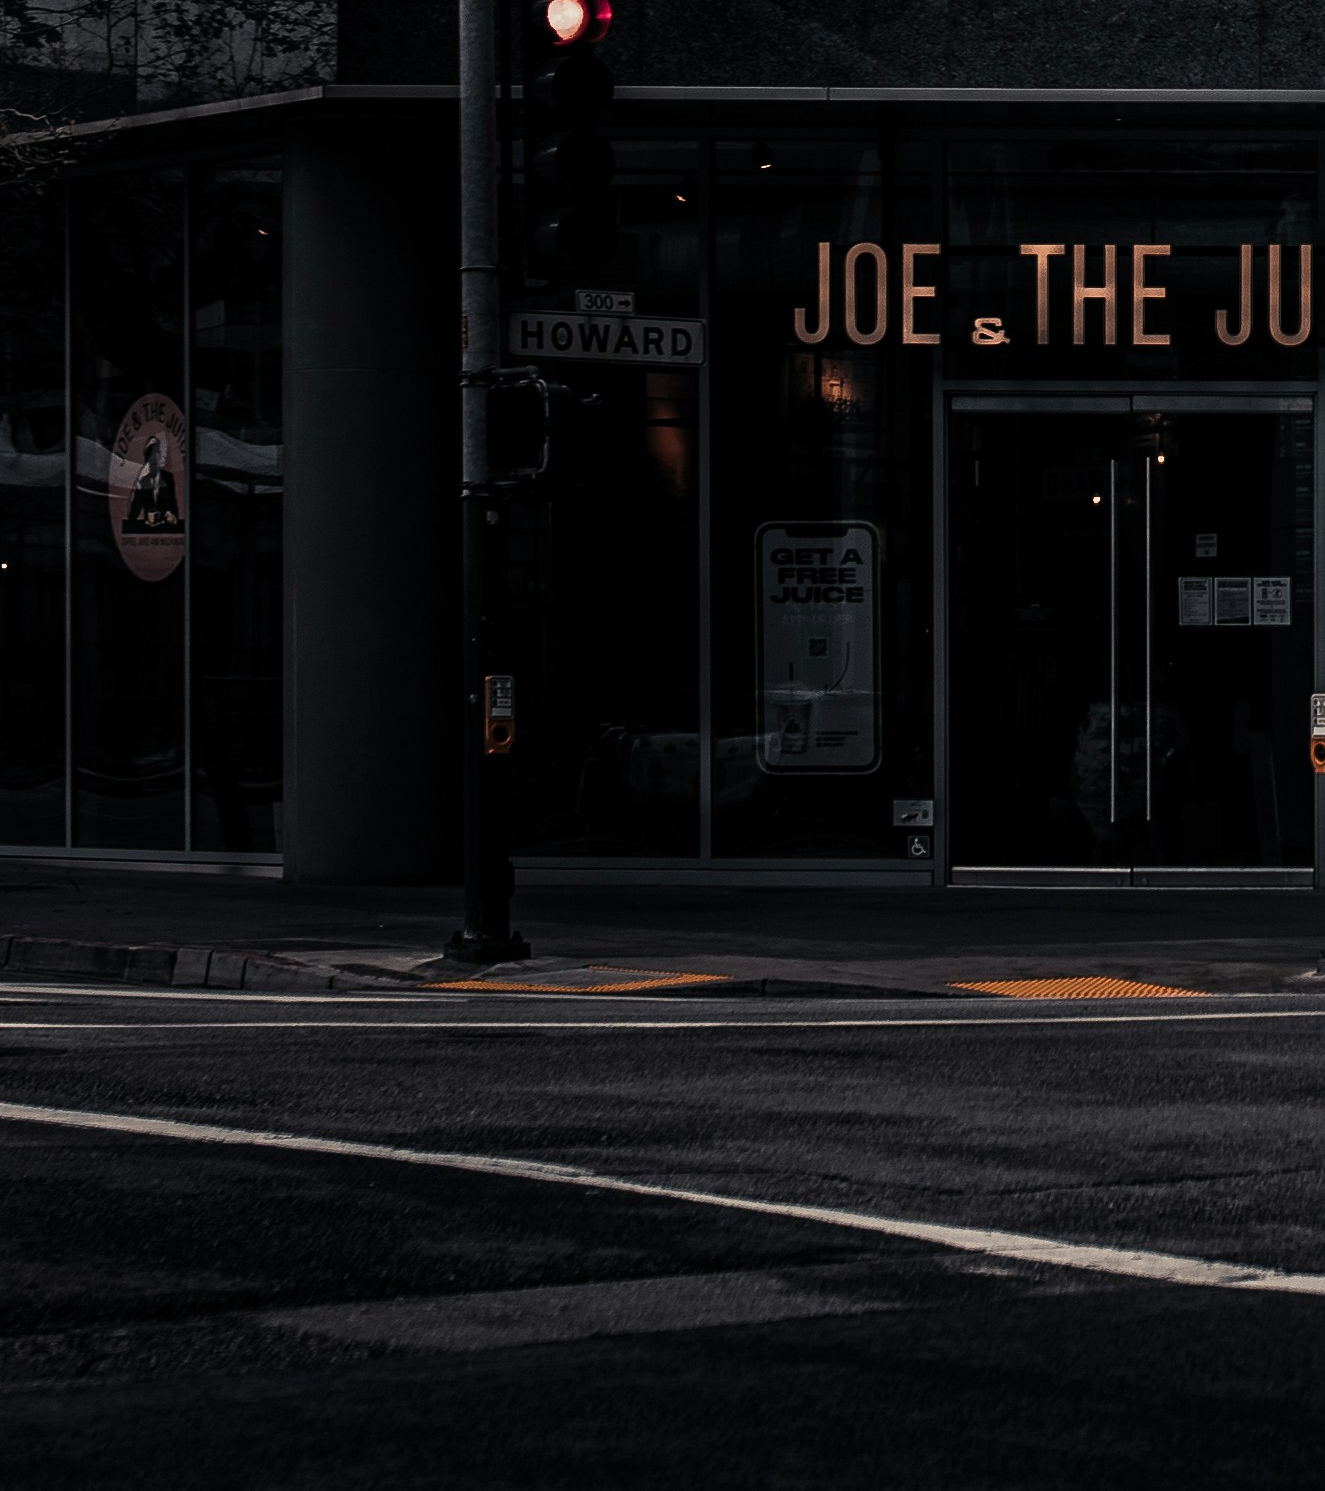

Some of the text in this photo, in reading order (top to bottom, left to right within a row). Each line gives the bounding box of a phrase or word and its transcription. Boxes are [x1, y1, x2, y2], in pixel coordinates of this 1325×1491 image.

[584, 293, 614, 311] 300
[792, 240, 942, 347] JOE
[969, 316, 1013, 347] &
[1018, 242, 1173, 348] THE
[520, 319, 693, 357] HOWARD
[142, 402, 166, 424] THE
[165, 412, 187, 455] JUIC
[770, 548, 864, 565] GET A
[777, 567, 857, 584] FREE
[770, 586, 864, 604] JUICE
